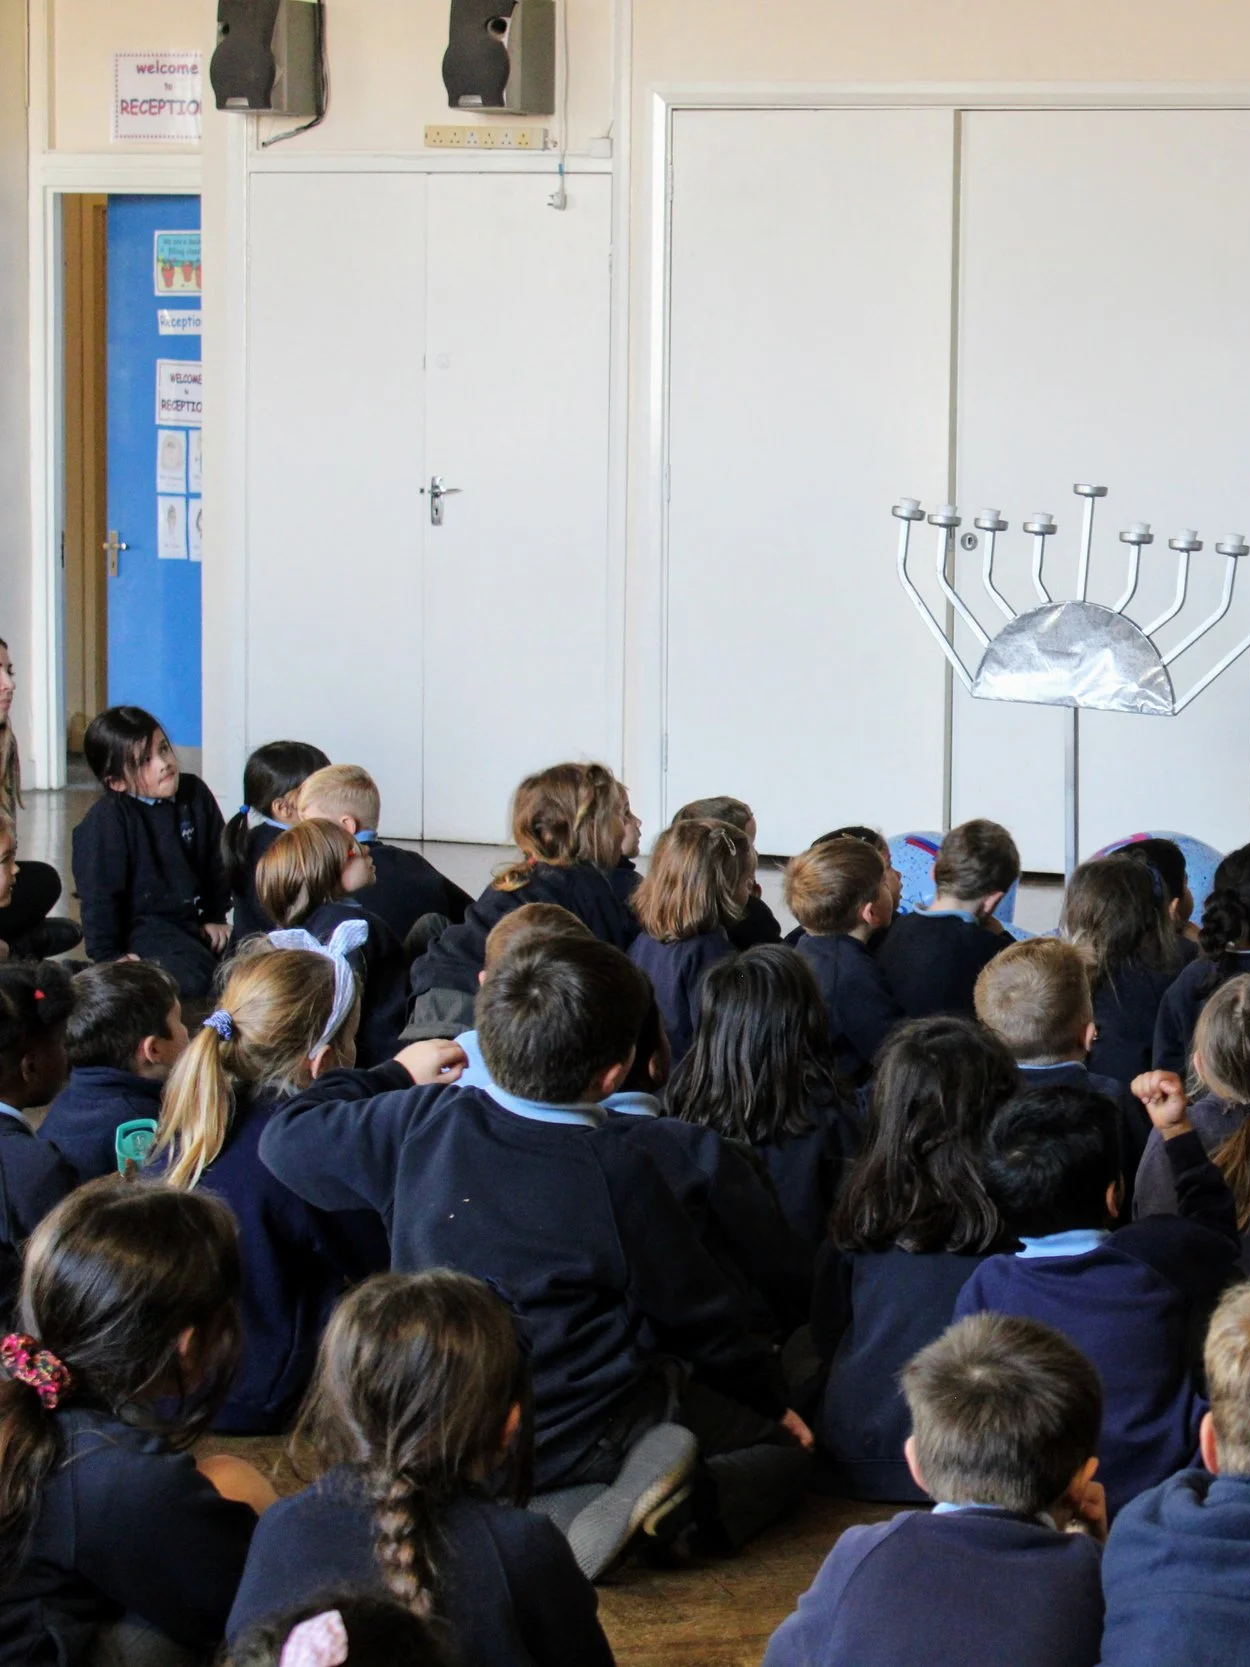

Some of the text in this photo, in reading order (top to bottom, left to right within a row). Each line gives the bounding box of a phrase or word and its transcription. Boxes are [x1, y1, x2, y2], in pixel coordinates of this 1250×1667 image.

[136, 60, 199, 74] welcome
[120, 99, 202, 115] RECEPTIO
[160, 314, 201, 330] Receptio
[161, 399, 203, 412] RECEPTIO
